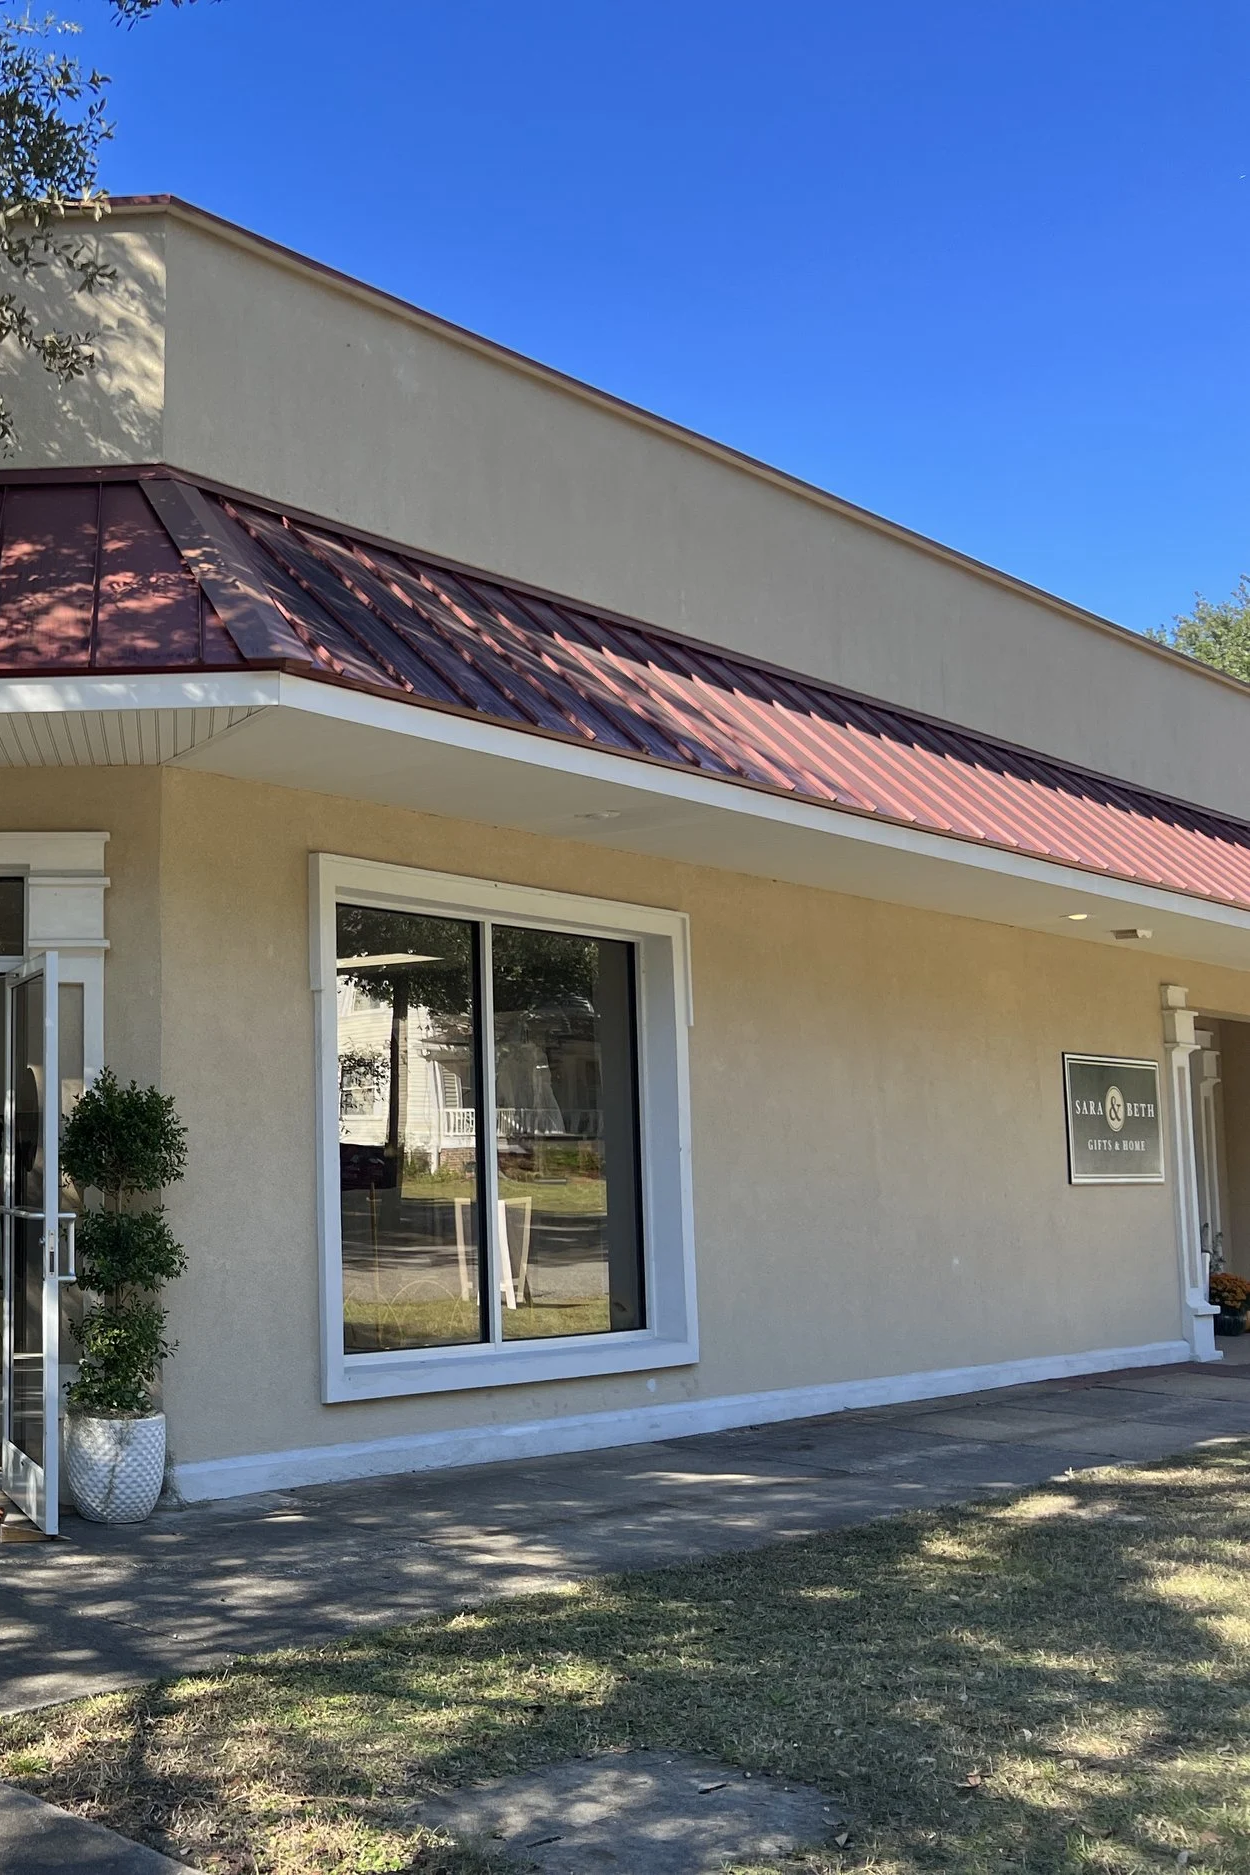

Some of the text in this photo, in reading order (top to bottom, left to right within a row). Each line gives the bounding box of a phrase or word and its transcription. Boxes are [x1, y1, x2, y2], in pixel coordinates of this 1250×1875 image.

[1075, 1096, 1155, 1122] SARA & BETH
[1087, 1139, 1146, 1151] GIFTS & HOME
